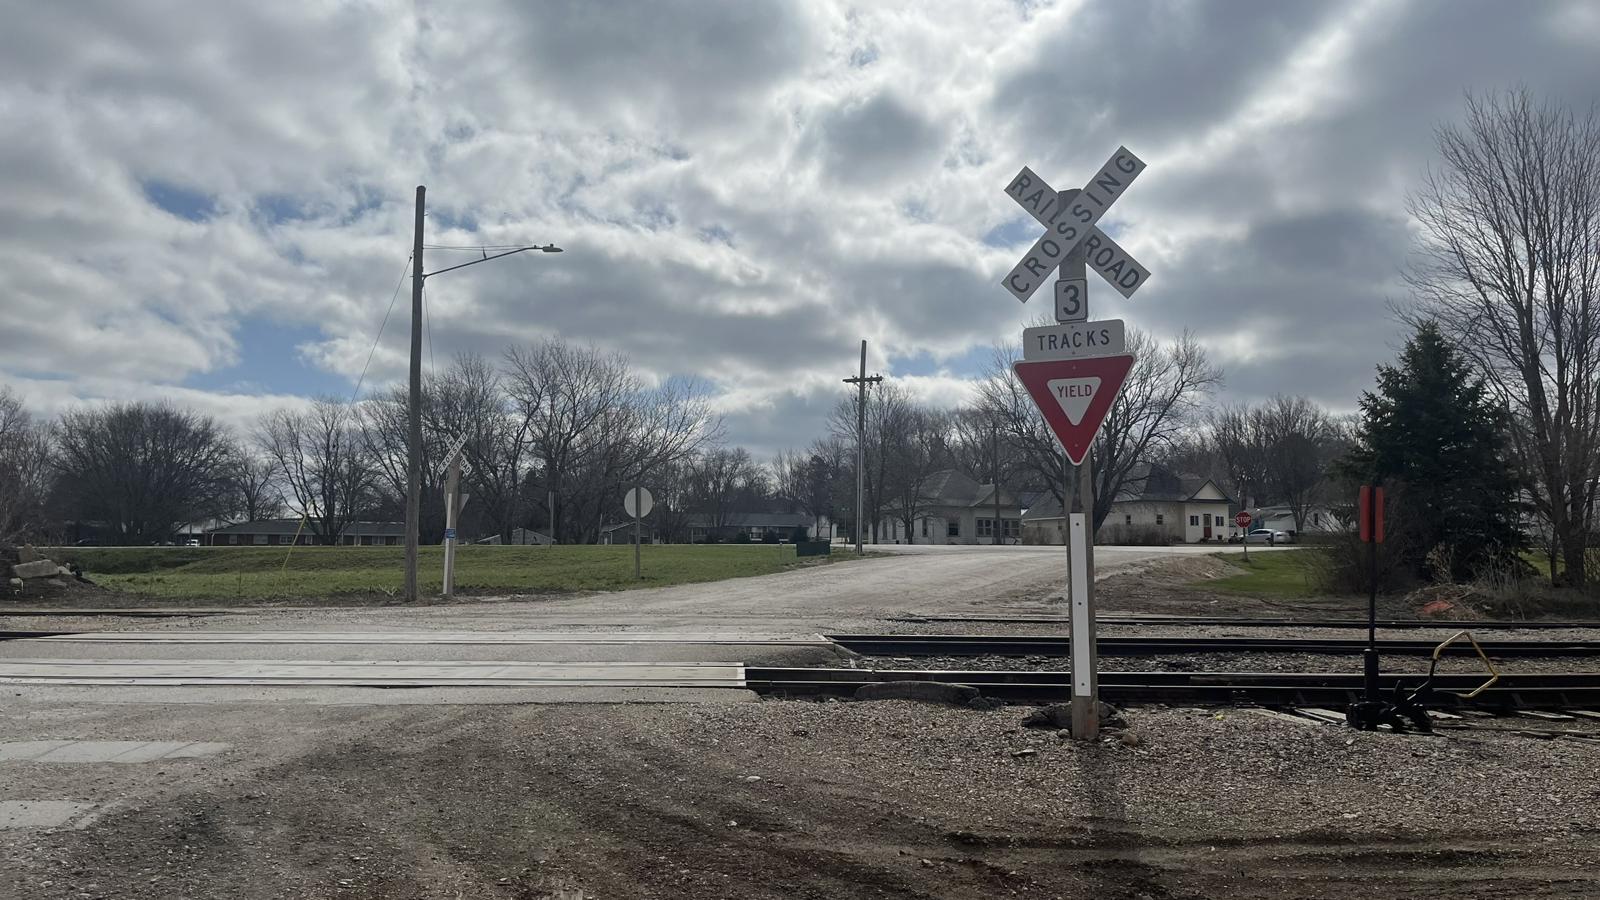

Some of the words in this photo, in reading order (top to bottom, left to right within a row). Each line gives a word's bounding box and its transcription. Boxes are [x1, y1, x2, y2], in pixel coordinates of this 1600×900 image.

[1010, 155, 1136, 293] CROSSING
[1011, 174, 1058, 225] RAIL
[1084, 234, 1140, 289] ROAD
[1063, 284, 1080, 315] 3
[1037, 329, 1110, 351] TRACKS
[1057, 384, 1092, 398] YIELD
[438, 433, 467, 473] CROSSING
